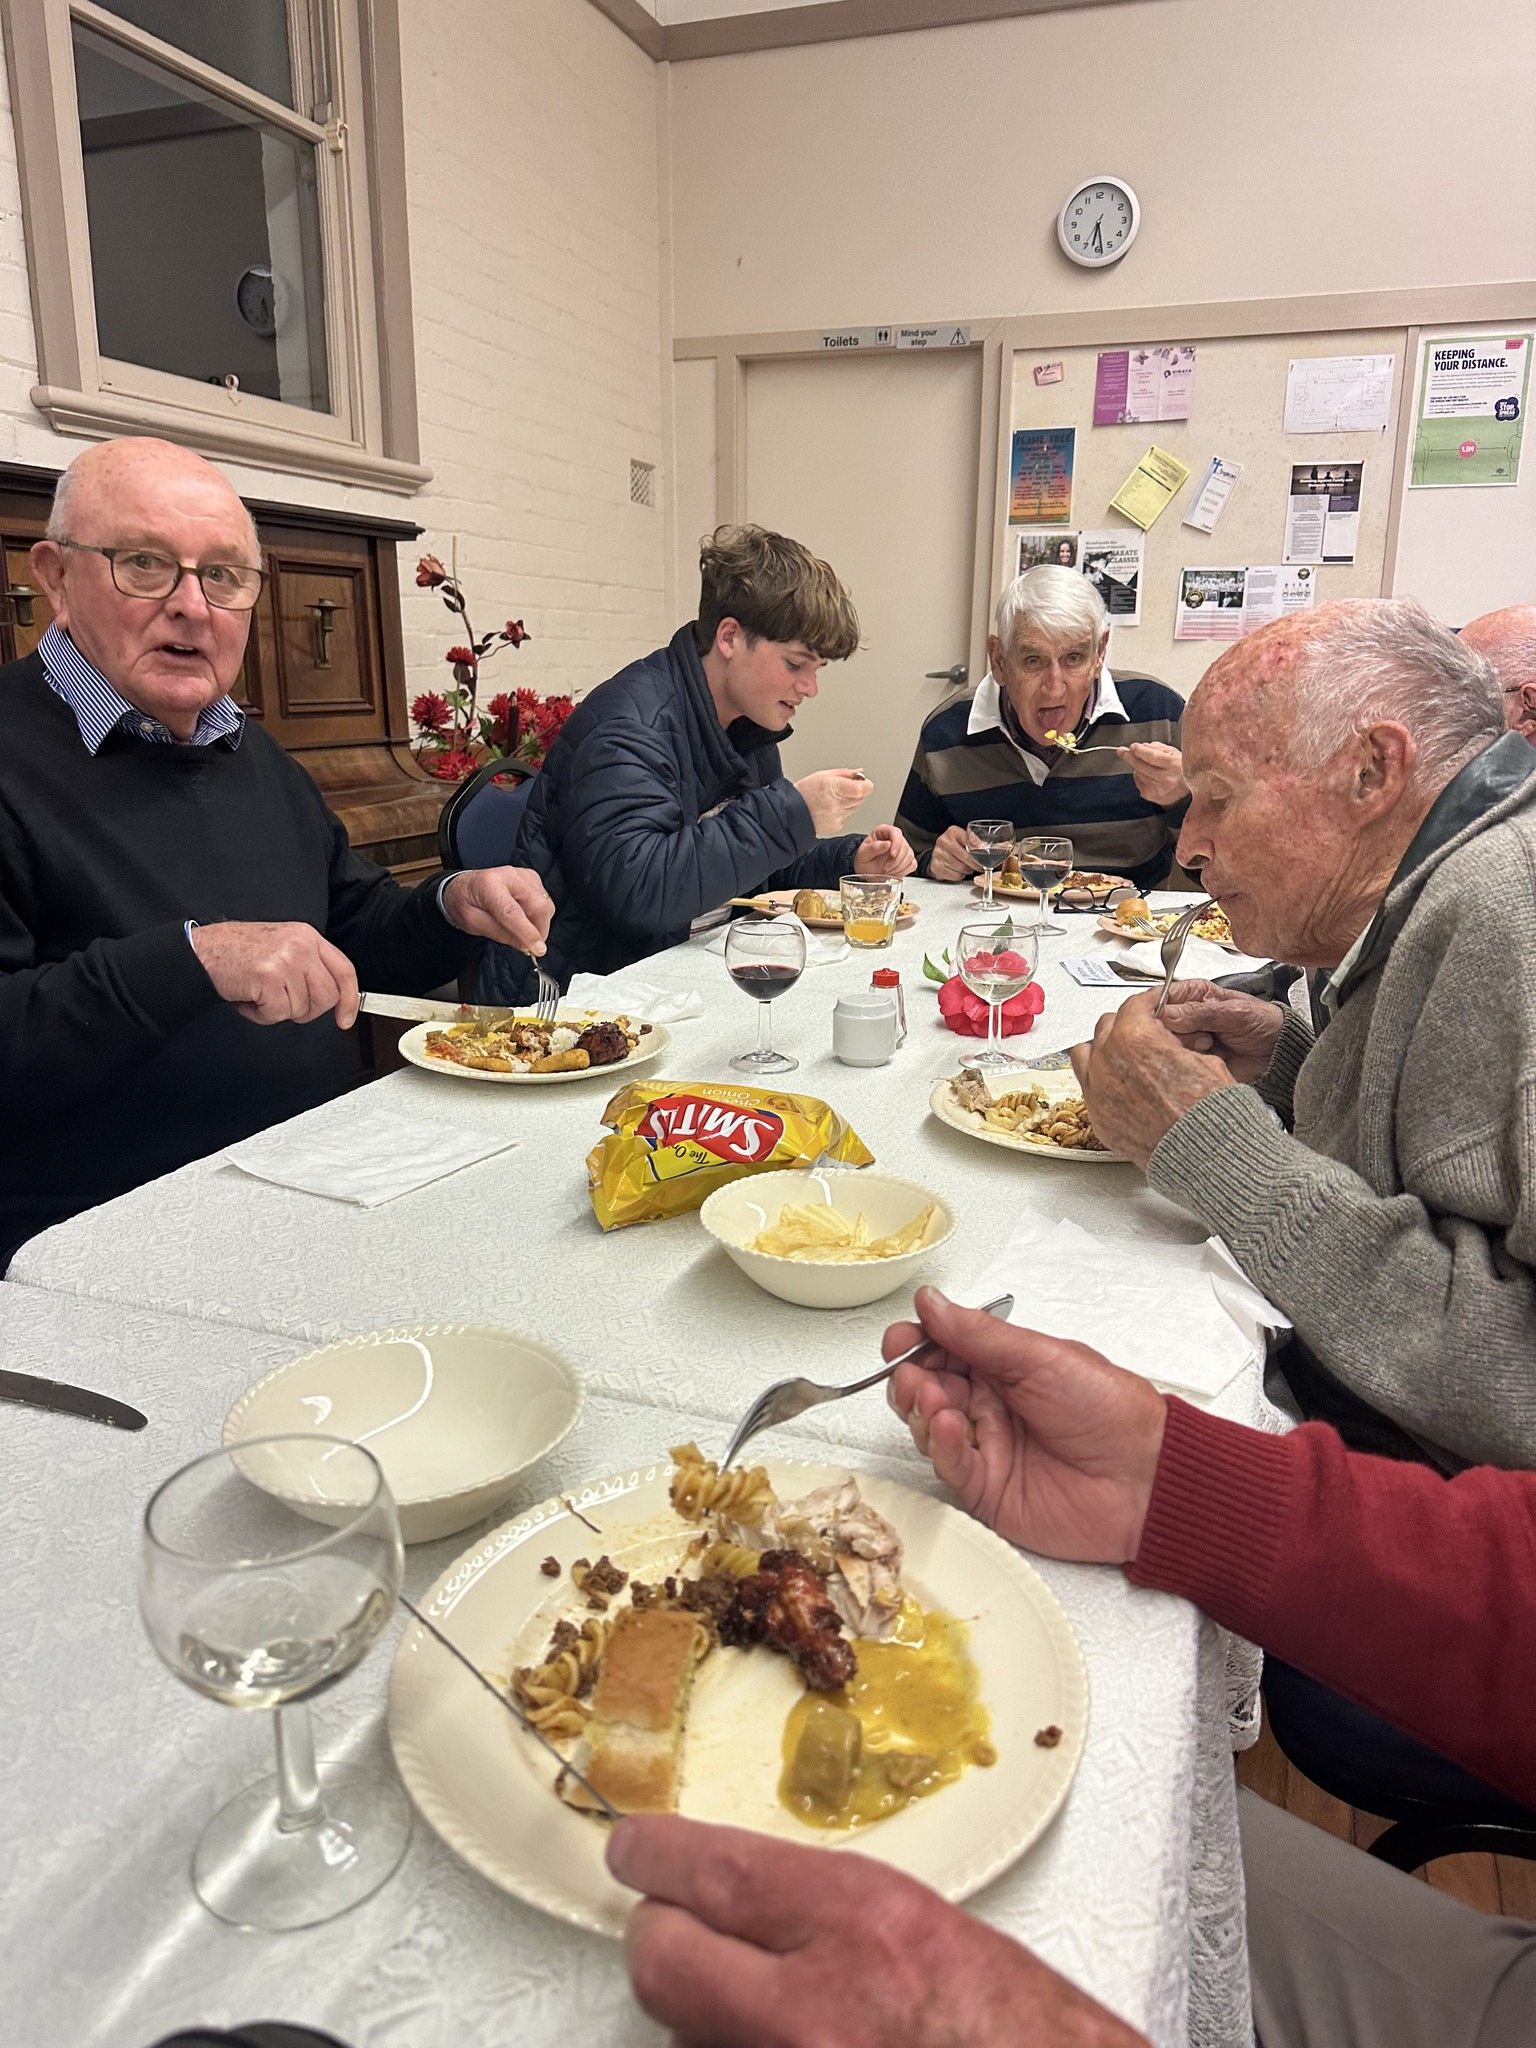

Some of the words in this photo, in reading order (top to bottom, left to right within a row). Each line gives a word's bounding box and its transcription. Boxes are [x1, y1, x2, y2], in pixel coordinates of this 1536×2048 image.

[1096, 191, 1104, 200] 12
[1085, 197, 1091, 205] 11
[1117, 203, 1123, 211] 2
[1121, 216, 1127, 224] 3
[1083, 242, 1089, 250] 7
[1095, 245, 1101, 253] 6
[901, 329, 919, 338] Mind
[920, 329, 938, 339] your
[823, 335, 860, 348] Toilets
[910, 338, 927, 347] step
[1434, 348, 1476, 361] KEEPING
[1434, 359, 1460, 372] YOUR
[1461, 357, 1509, 371] DISTANCE.
[1110, 549, 1139, 557] KARATE
[1109, 556, 1140, 564] CLASSES
[702, 1088, 751, 1099] Onion
[688, 1150, 710, 1165] The
